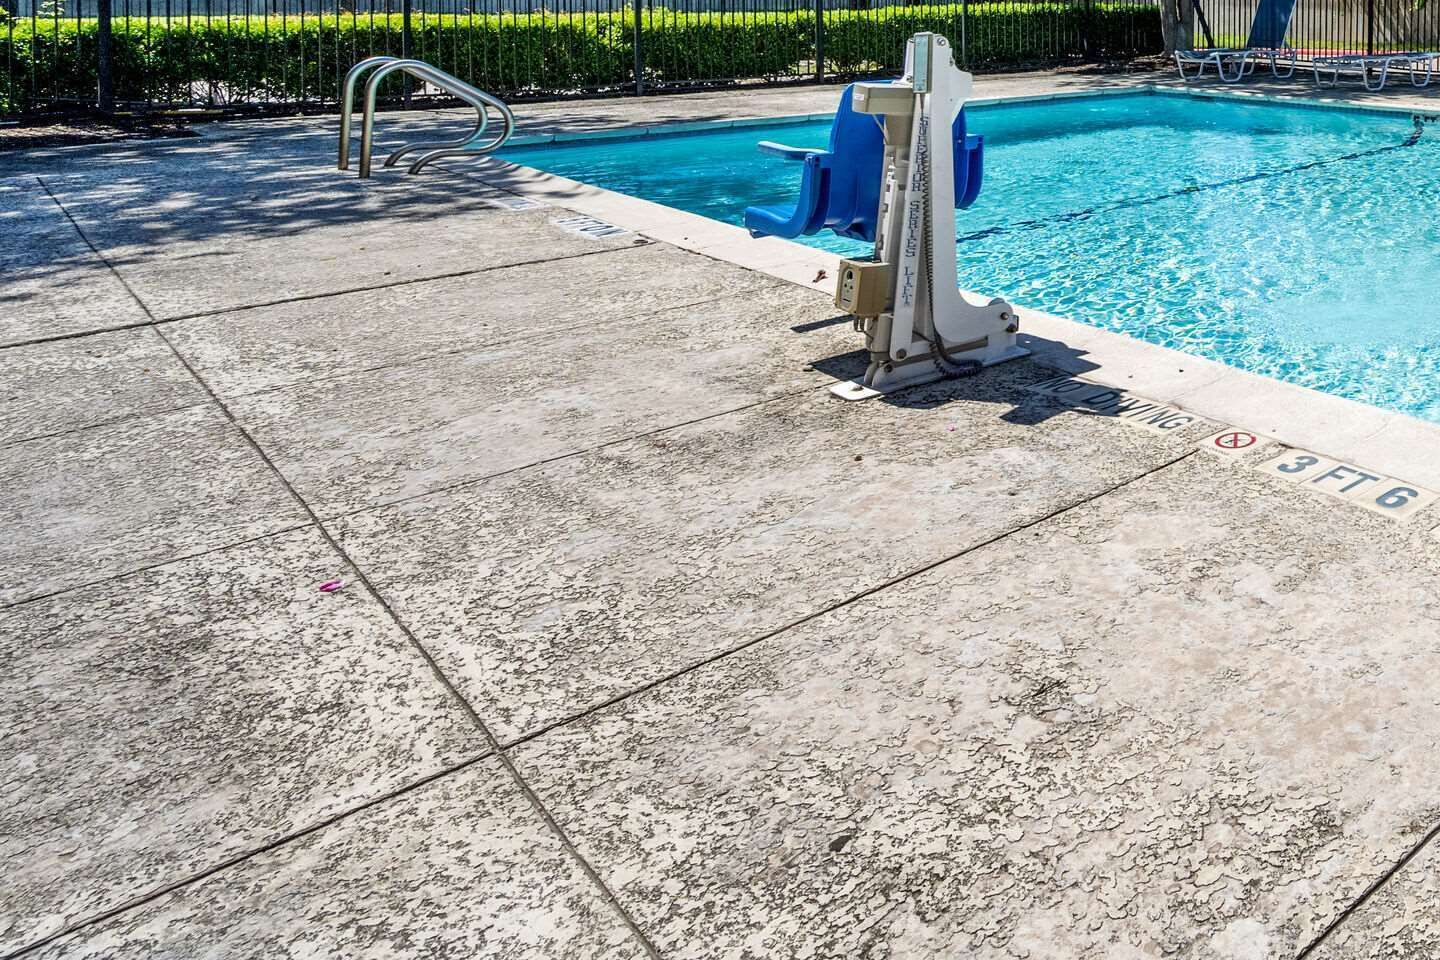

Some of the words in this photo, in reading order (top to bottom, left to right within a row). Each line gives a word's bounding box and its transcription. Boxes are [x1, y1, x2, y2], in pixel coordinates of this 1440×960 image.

[905, 201, 920, 257] SERIES
[902, 266, 914, 306] LIFT
[1034, 376, 1086, 393] NO
[1082, 391, 1194, 429] DIVING
[1277, 455, 1319, 474] 3
[1312, 465, 1380, 493] FT
[1375, 486, 1419, 509] 6
